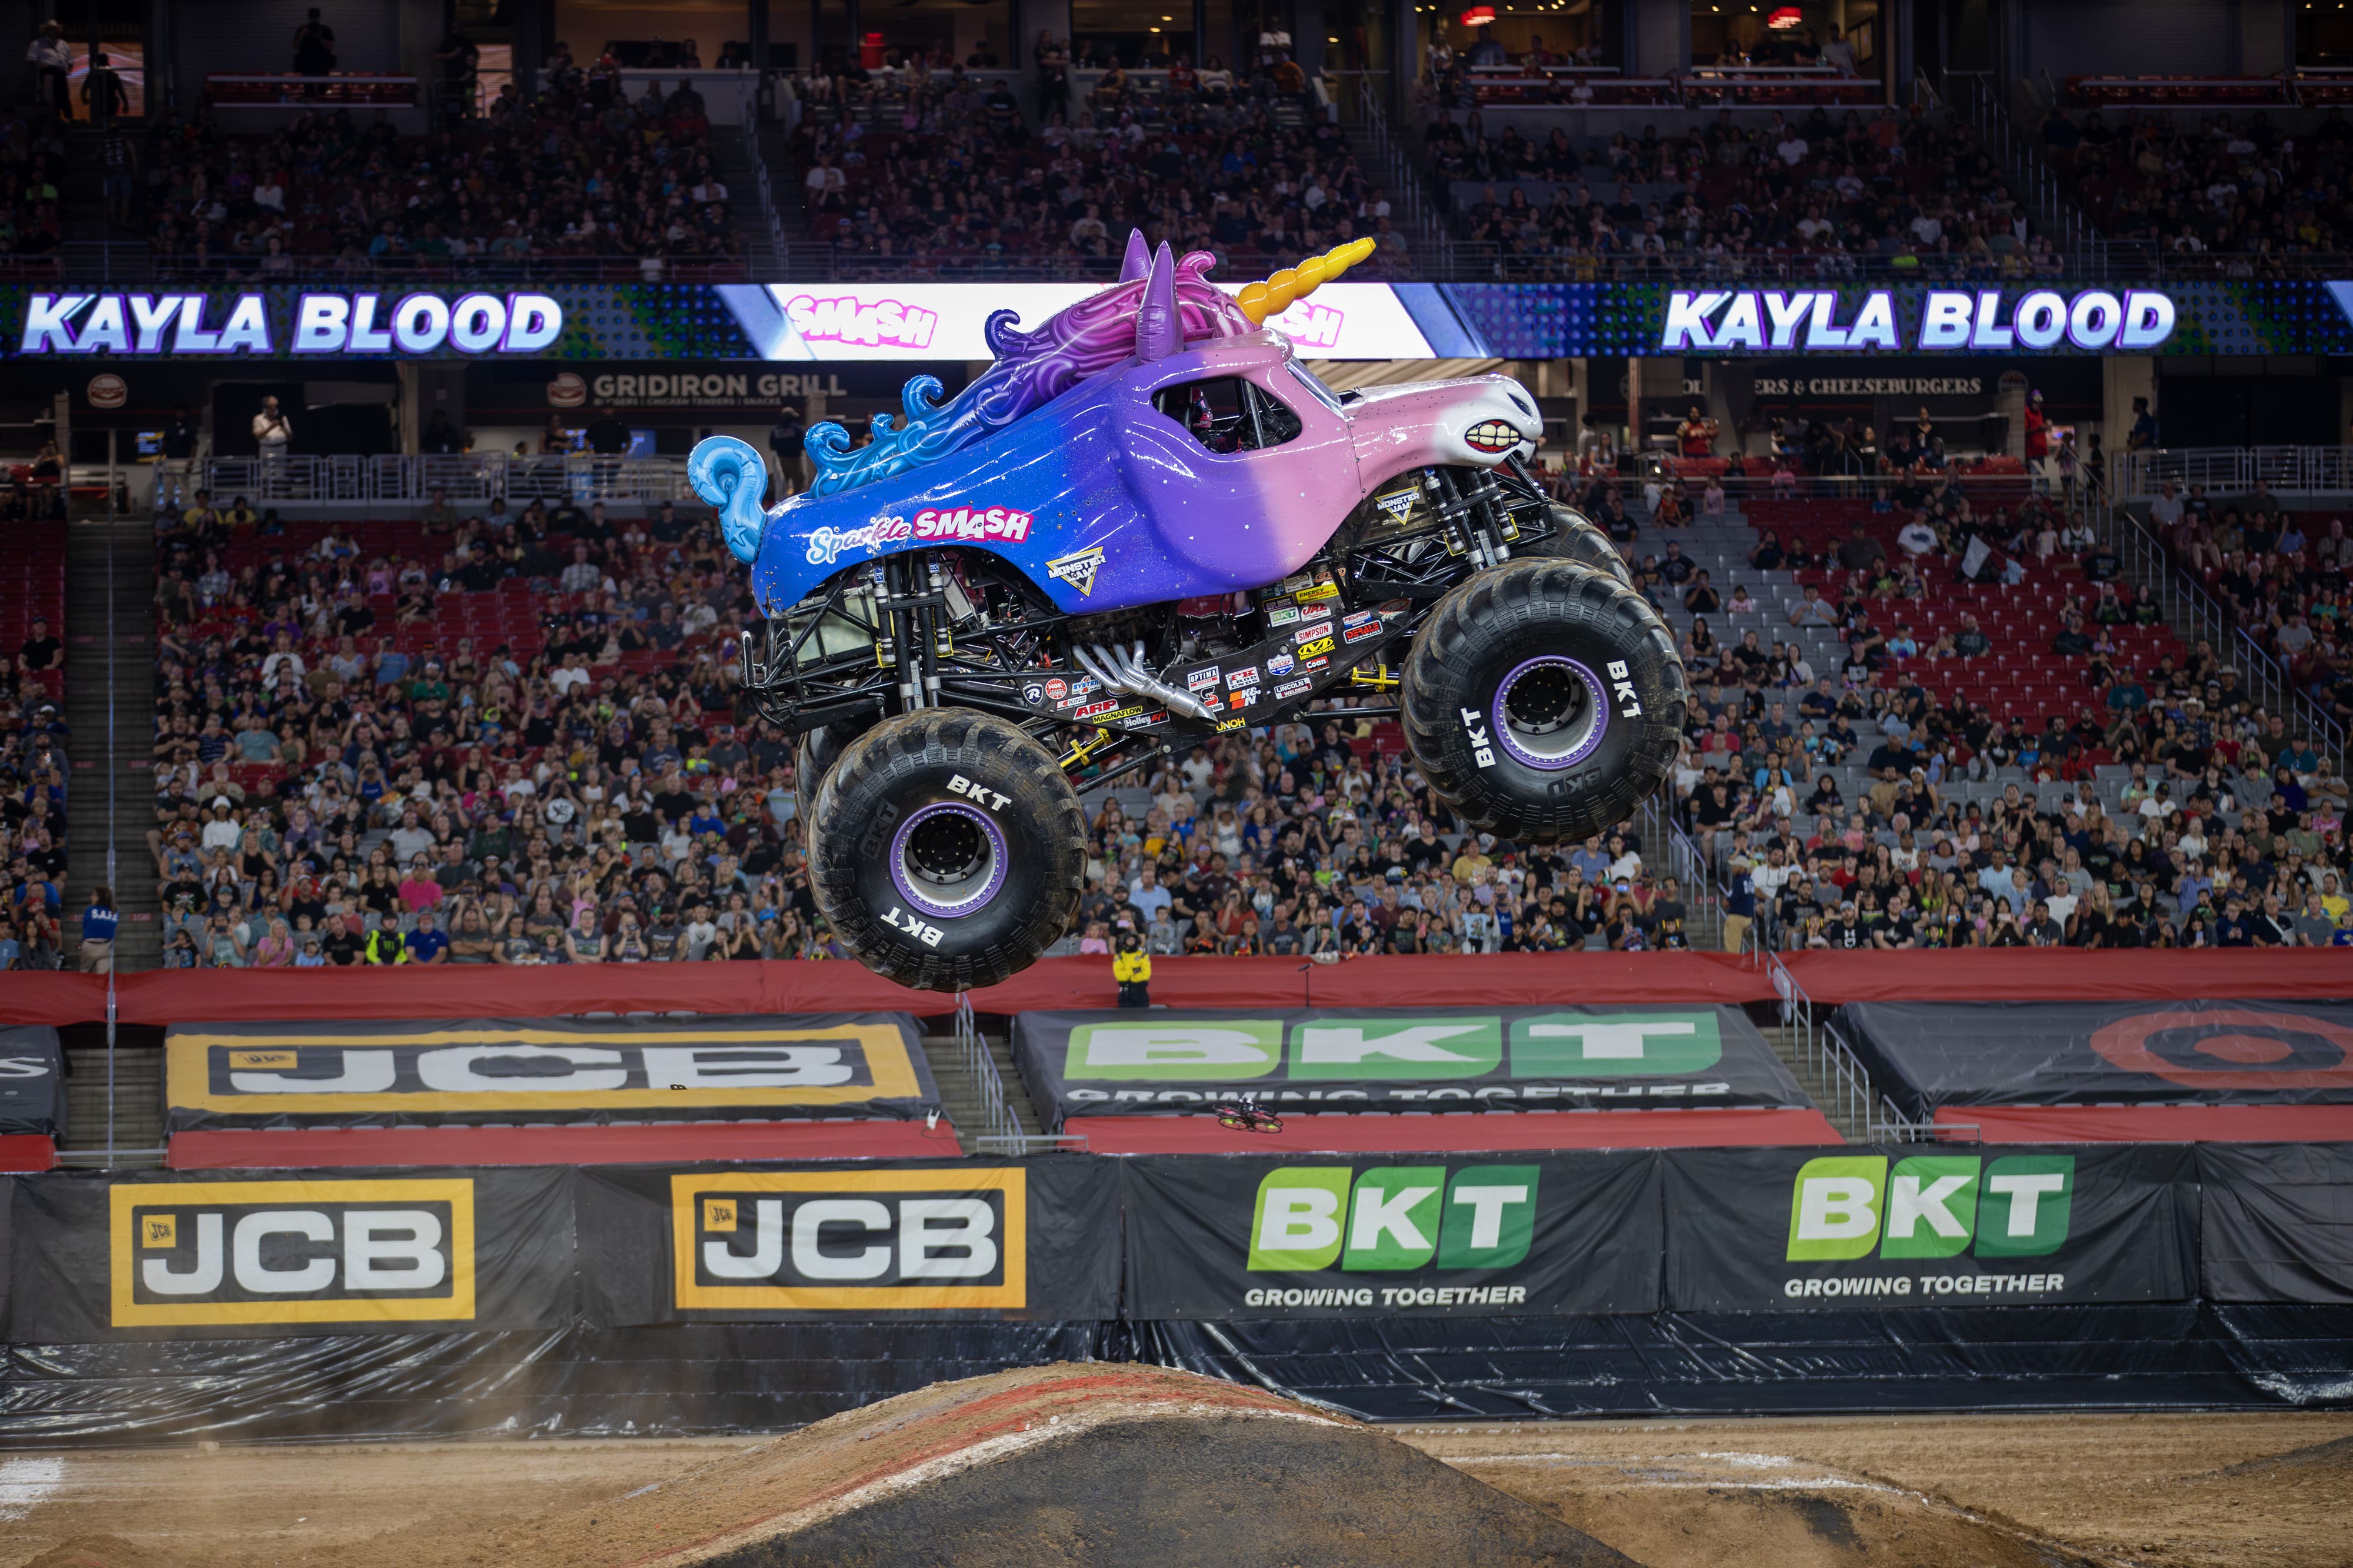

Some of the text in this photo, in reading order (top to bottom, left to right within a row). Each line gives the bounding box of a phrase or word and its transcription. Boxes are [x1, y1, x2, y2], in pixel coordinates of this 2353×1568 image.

[22, 292, 563, 353] KAYLA BLOOD
[784, 295, 938, 348] SMASH
[1661, 289, 2176, 351] KAYLA BLOOD
[593, 374, 848, 397] GRIDIRON GRILL
[1809, 377, 1982, 395] CHEESEBURGERS
[1377, 492, 1420, 511] MONSTER
[1391, 503, 1411, 513] JAM
[806, 509, 1032, 565] Sparkle SMASH
[1048, 554, 1107, 580] MONSTER
[1066, 568, 1095, 582] JAM
[1299, 588, 1325, 598] ENERGY
[1272, 608, 1297, 622] BKT
[1302, 602, 1328, 615] JAZ
[1298, 624, 1329, 641] SIMPSON
[1345, 622, 1380, 639] DERALE
[1348, 629, 1381, 642] PERFORMANCE
[1299, 645, 1336, 660] MECHANIX WEAR
[1272, 659, 1291, 669] LUCAS
[1306, 658, 1327, 669] Coan
[1190, 669, 1217, 683] OPTIMA
[1231, 679, 1258, 689] ENDS
[1232, 669, 1256, 681] FK
[1276, 680, 1304, 693] LINCOLN
[1284, 685, 1308, 697] WELDERS
[1607, 660, 1642, 718] BKT
[1068, 696, 1085, 705] KING
[1075, 700, 1117, 718] ARP
[1094, 706, 1142, 723] MAGNAFLOW
[1125, 716, 1151, 727] Holley
[1216, 716, 1246, 731] UNOH
[1461, 708, 1496, 768] BKT
[946, 774, 1012, 811] BKT
[1698, 895, 1714, 903] 10
[880, 907, 944, 948] BKT
[1085, 1020, 1696, 1067] BKT
[229, 1045, 854, 1094] JCB
[712, 1205, 734, 1223] JCB
[1797, 1172, 2065, 1240] BKT
[1258, 1185, 1529, 1252] BKT
[149, 1220, 171, 1241] JCB
[703, 1199, 998, 1280] JCB
[142, 1210, 445, 1295] JCB
[1784, 1273, 2065, 1298] GROWING TOGETHER
[1244, 1286, 1527, 1307] GROWING TOGETHER
